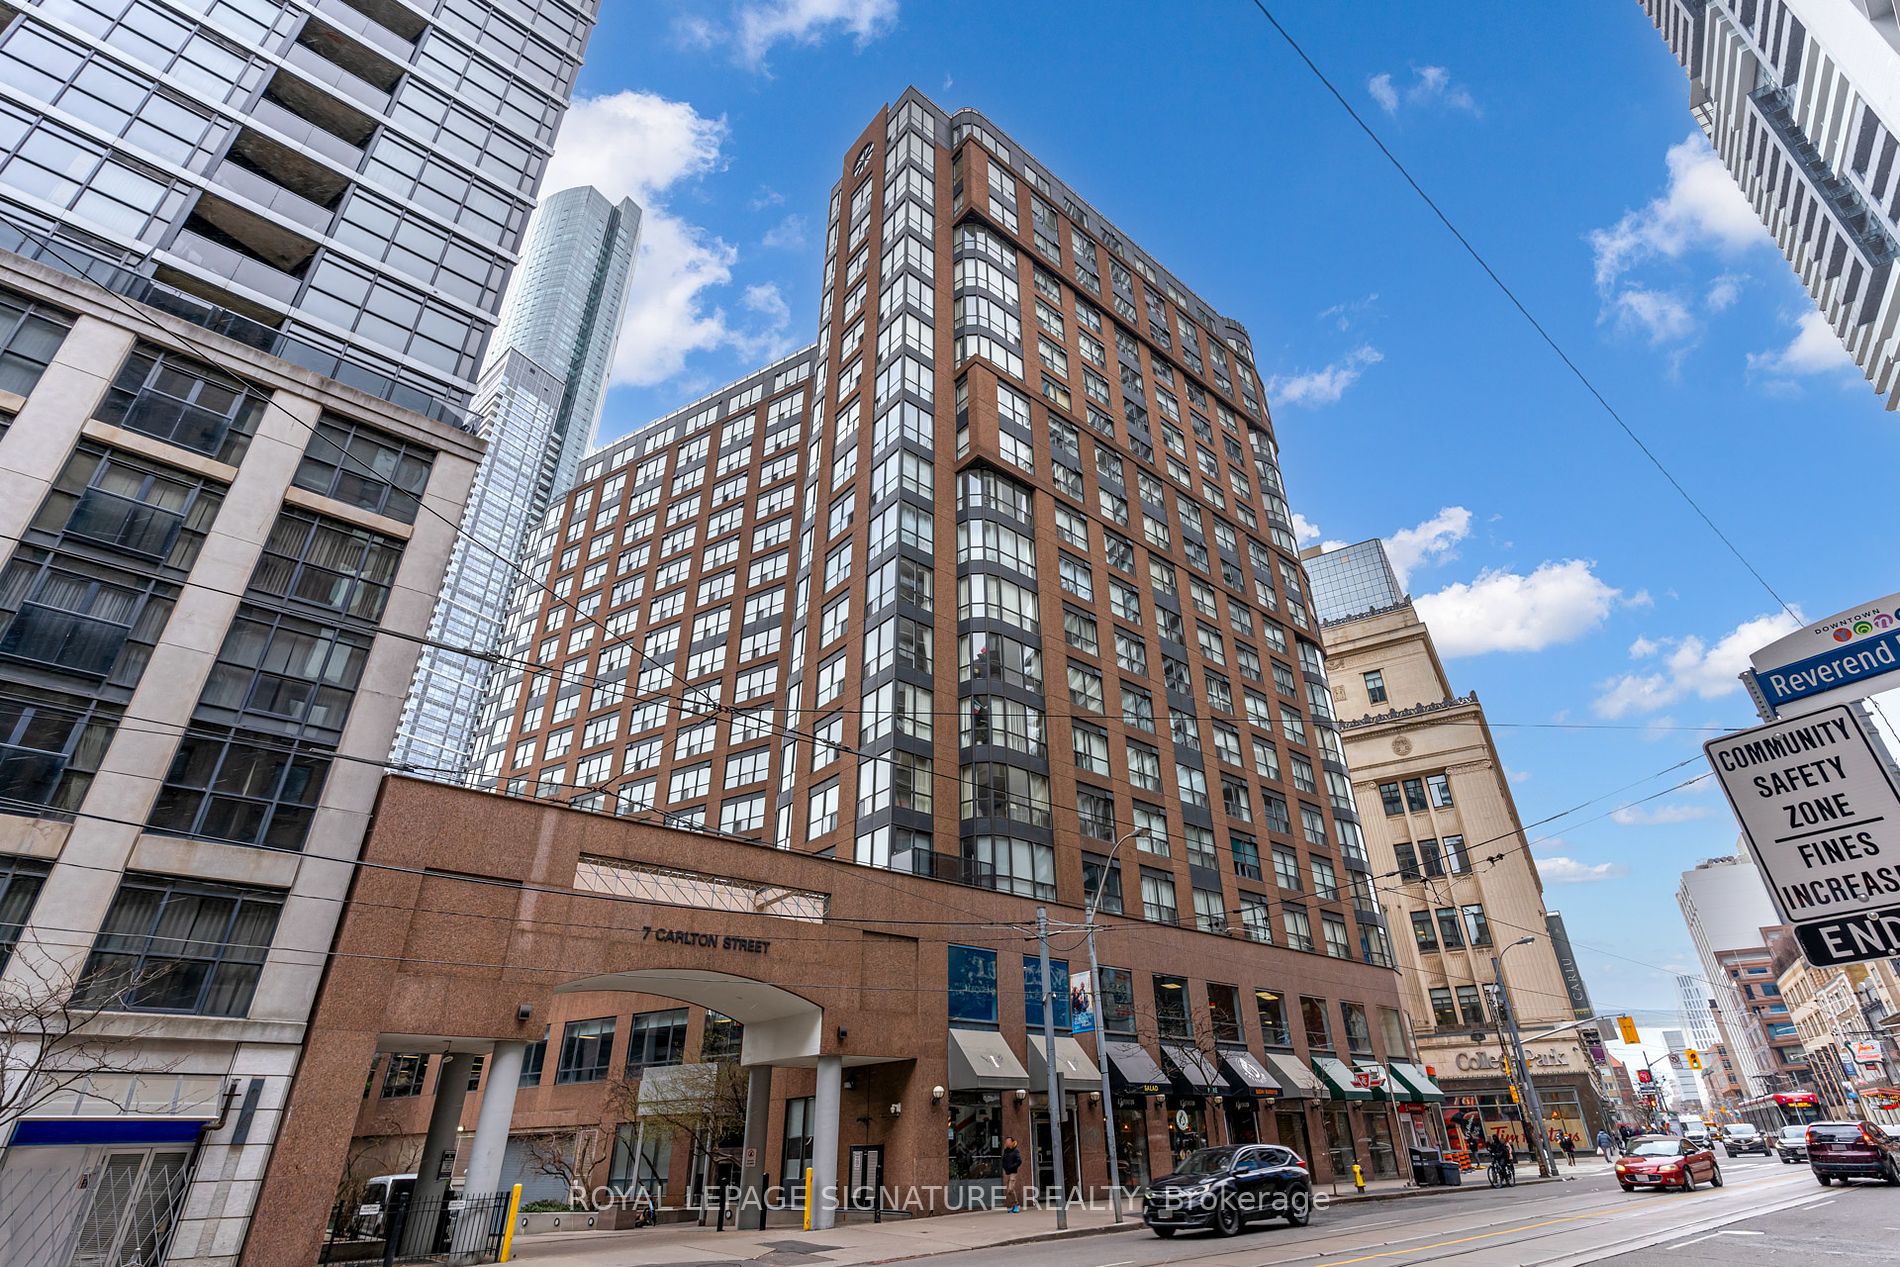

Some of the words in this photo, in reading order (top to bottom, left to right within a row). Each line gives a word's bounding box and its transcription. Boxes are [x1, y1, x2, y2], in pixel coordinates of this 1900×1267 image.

[1815, 608, 1880, 635] DOWNTOWN
[1770, 640, 1896, 697] Reverend
[1718, 717, 1850, 772] COMMUNITY
[1753, 756, 1846, 798] SAFETY
[1783, 793, 1855, 829] ZONE
[1797, 832, 1880, 868] FINES
[642, 926, 652, 940] 7
[655, 928, 719, 948] CARLTON
[723, 936, 771, 954] STREET
[1561, 958, 1583, 1001] CARLU
[1456, 1051, 1517, 1073] Colleg
[1490, 1126, 1520, 1144] Tim
